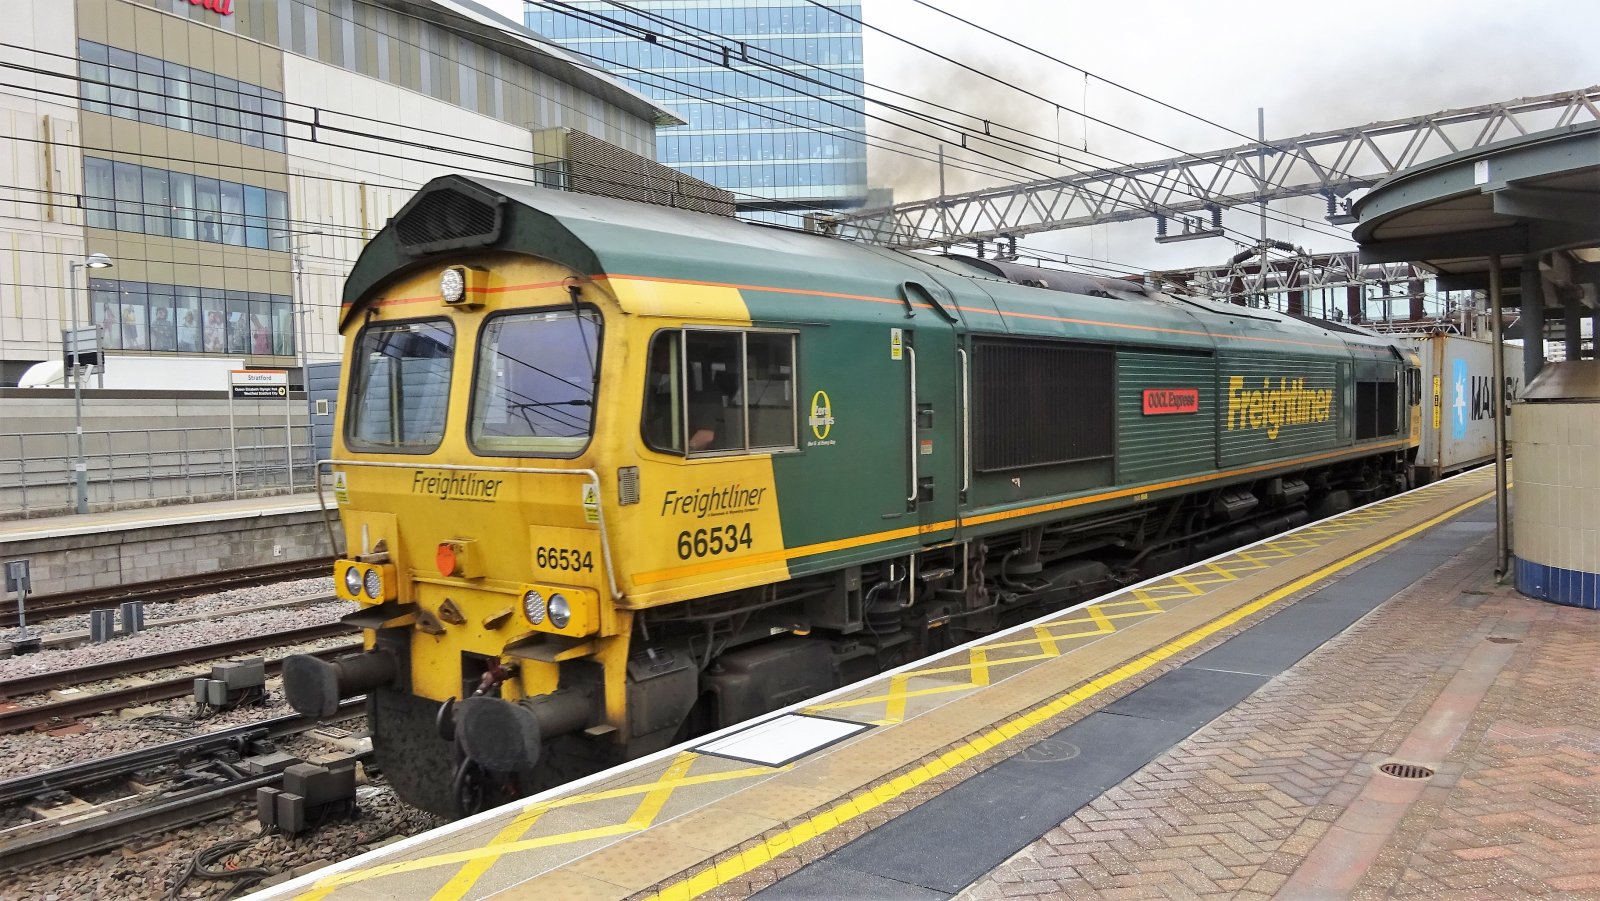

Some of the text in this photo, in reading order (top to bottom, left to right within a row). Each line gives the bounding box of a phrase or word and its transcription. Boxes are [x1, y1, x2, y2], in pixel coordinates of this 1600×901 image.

[1148, 392, 1194, 410] OOCL Express
[1227, 376, 1332, 440] Freightliner
[412, 470, 502, 500] Freightliner
[661, 484, 767, 518] Freightliner
[677, 522, 753, 560] 66534
[537, 546, 594, 573] 66534
